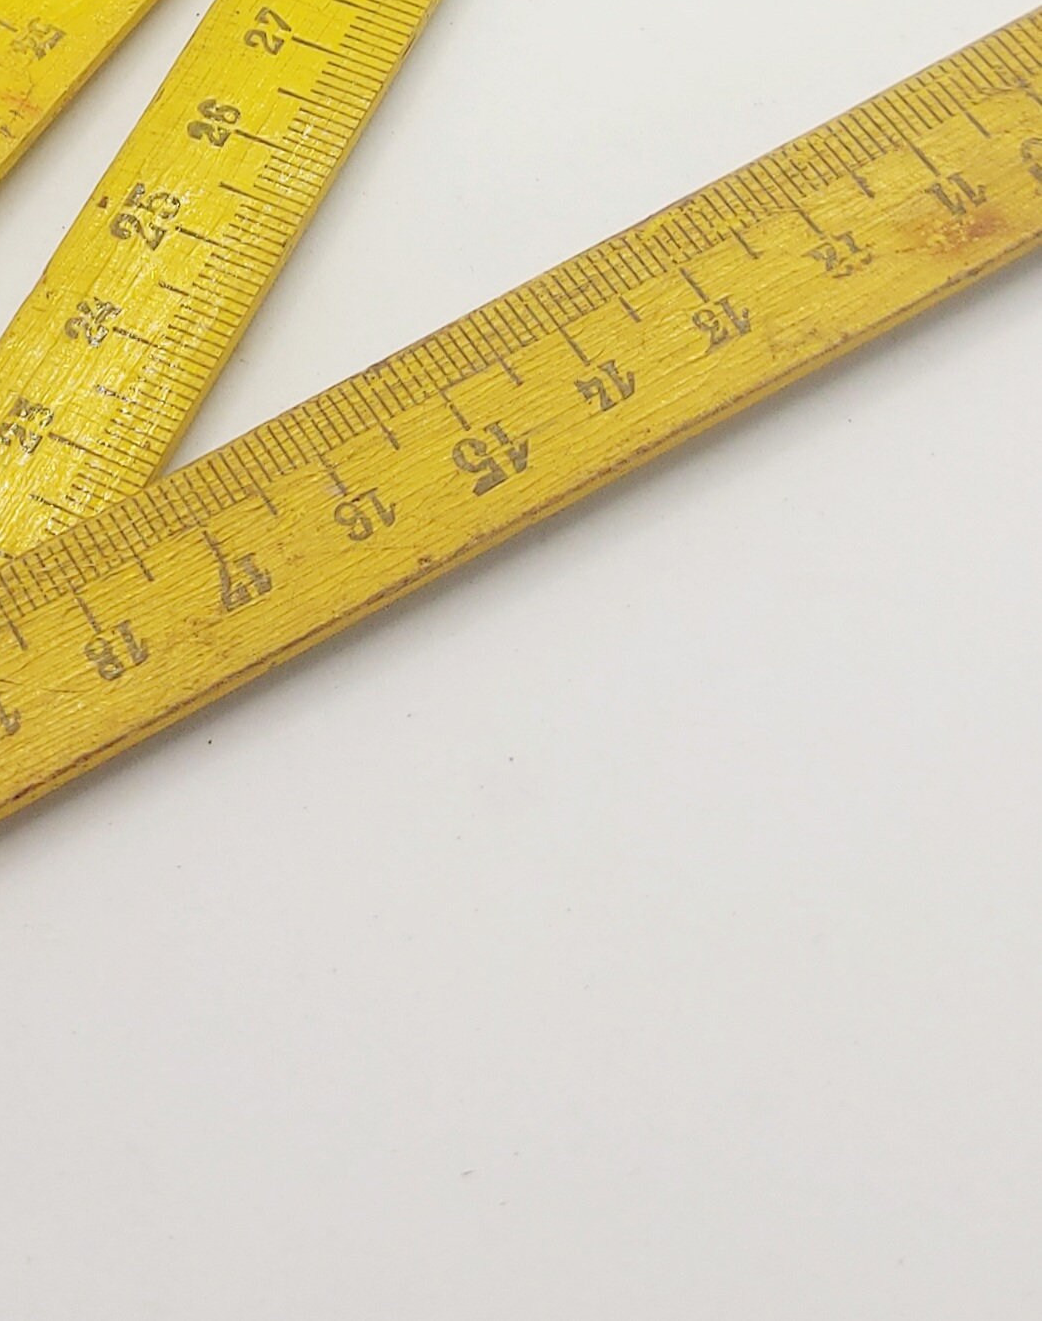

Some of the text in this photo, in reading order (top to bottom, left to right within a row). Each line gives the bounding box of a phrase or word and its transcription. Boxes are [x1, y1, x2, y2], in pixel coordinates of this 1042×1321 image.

[110, 182, 181, 251] 25
[187, 99, 241, 147] 26
[244, 7, 292, 55] 27
[926, 171, 987, 216] 11
[692, 296, 752, 348] 13
[574, 359, 636, 411] 14
[452, 421, 528, 497] 15
[334, 487, 397, 541] 16
[218, 552, 272, 612] 17
[84, 619, 149, 681] 18
